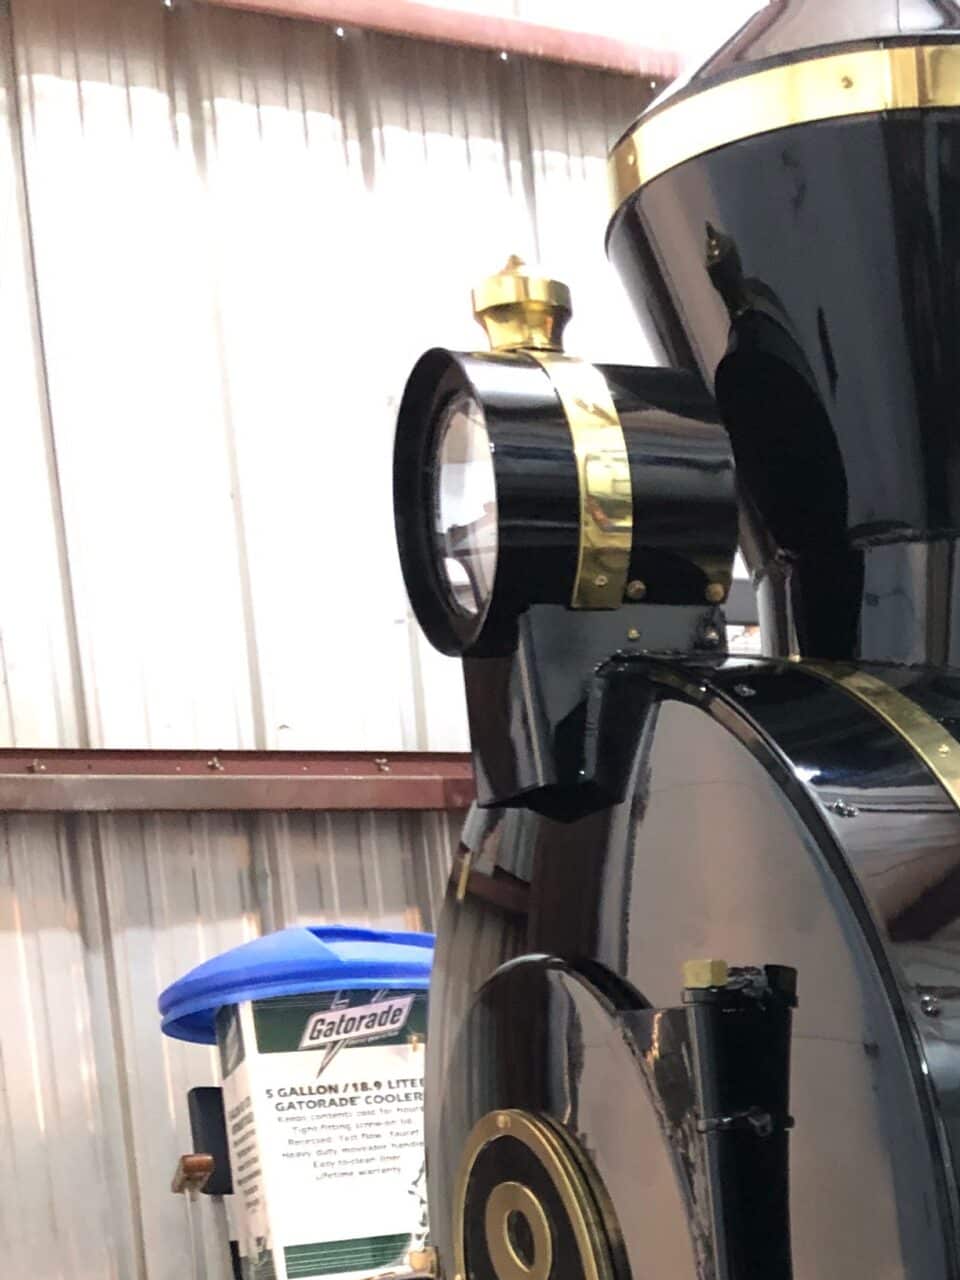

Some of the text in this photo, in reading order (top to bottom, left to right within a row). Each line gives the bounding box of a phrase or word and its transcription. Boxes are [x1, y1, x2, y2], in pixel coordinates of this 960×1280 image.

[309, 1005, 403, 1041] Gatorade
[265, 1088, 274, 1099] 5
[277, 1083, 339, 1098] GALLON
